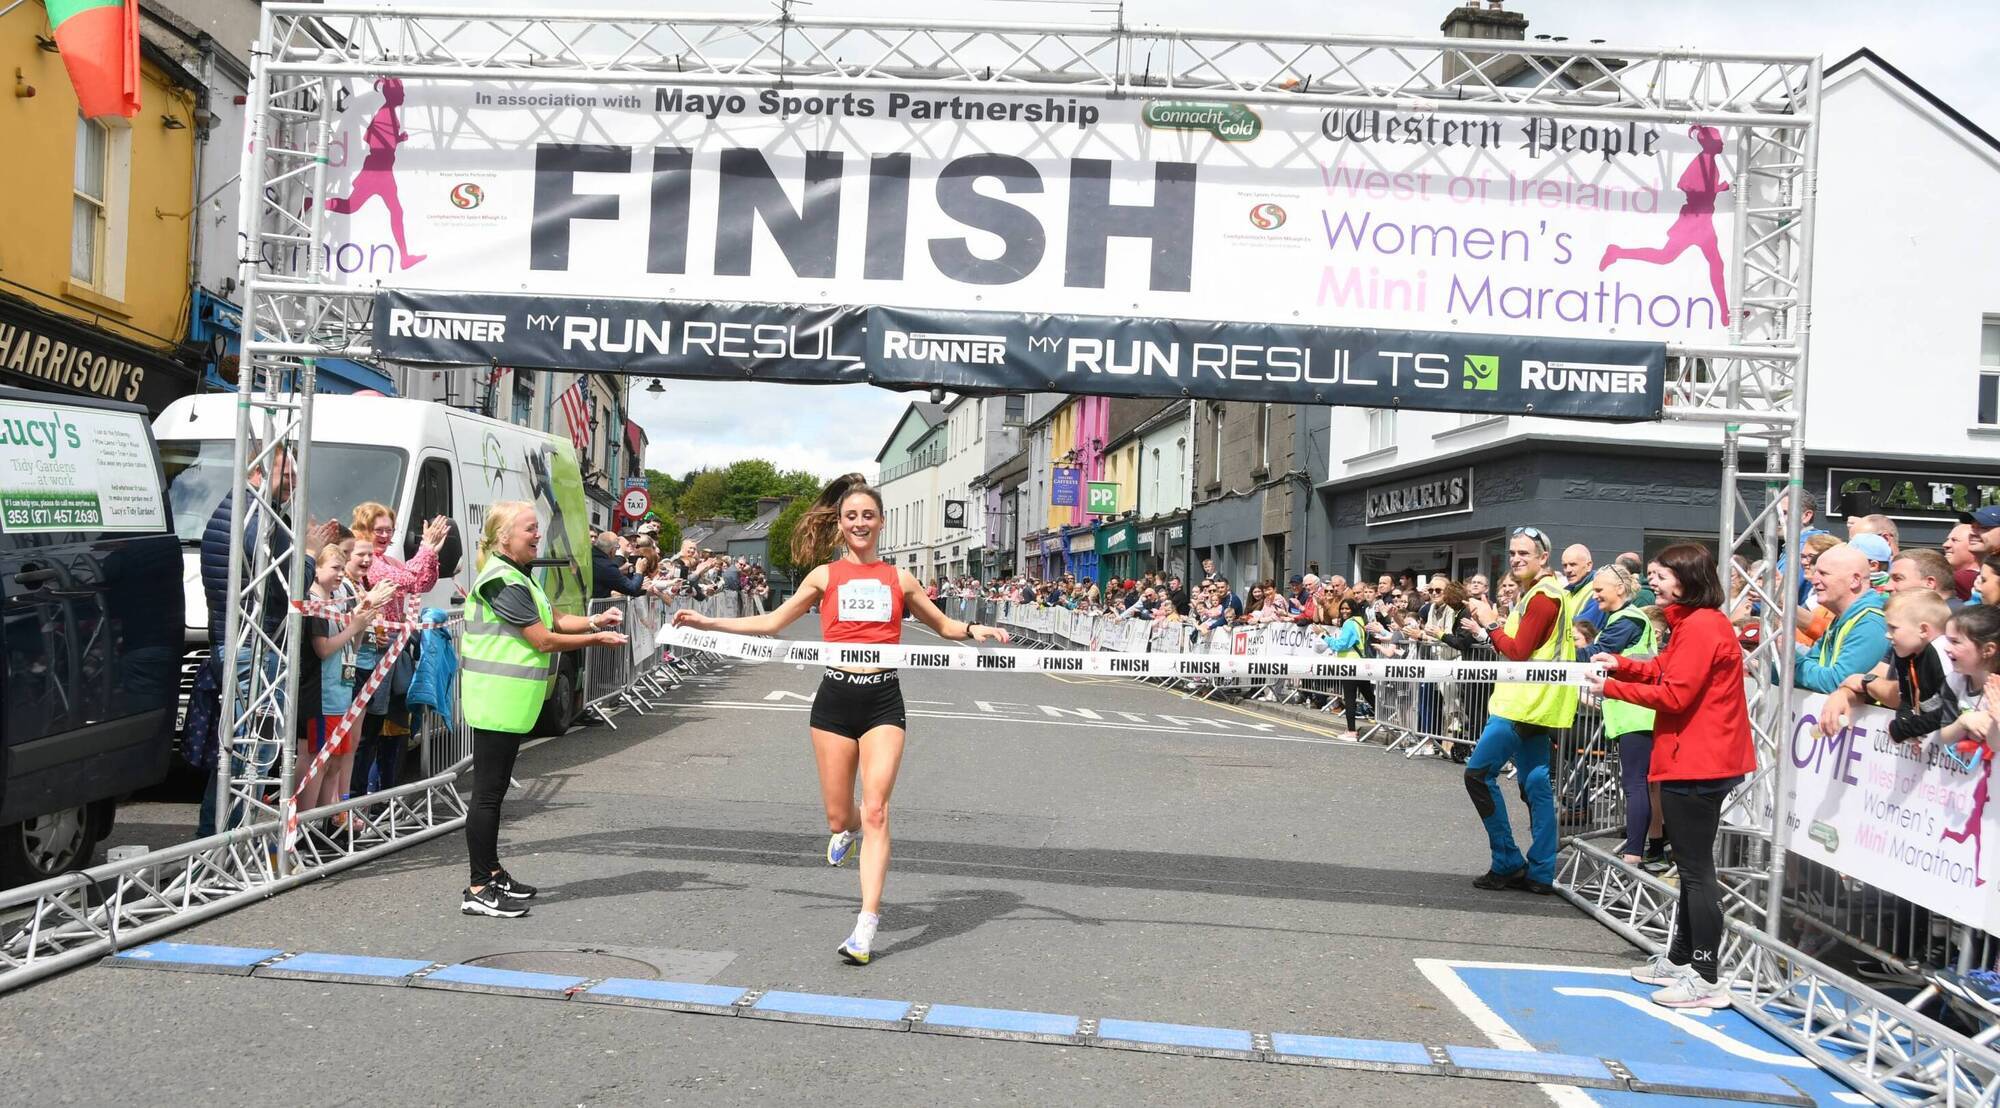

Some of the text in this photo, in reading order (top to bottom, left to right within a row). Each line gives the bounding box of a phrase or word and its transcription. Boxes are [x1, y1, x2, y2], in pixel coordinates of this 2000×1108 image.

[476, 87, 1099, 130] In association with Mayo Sports Partnership
[1149, 104, 1224, 125] Connacht
[1219, 119, 1255, 136] Gold
[1319, 107, 1661, 164] Western People
[1319, 161, 1659, 214] West of Ireland
[529, 142, 1197, 293] FINISH
[1321, 209, 1573, 265] Women's
[1316, 265, 1714, 330] Mini Marathon
[389, 308, 506, 344] RUNNER
[526, 313, 868, 362] MY RUN RESUL
[0, 323, 145, 402] HARRISON'S
[883, 330, 1007, 365] RUNNER
[1028, 335, 1450, 390] MY RUN RESULTS
[1520, 359, 1648, 394] RUNNER
[10, 458, 77, 475] Tidy Gardens
[627, 501, 643, 509] TAXI
[1367, 476, 1464, 519] CARMEL'S
[7, 508, 99, 524] 353 (87) 457 2630
[841, 598, 875, 610] 1232
[1248, 635, 1265, 646] MAYO
[1271, 629, 1314, 649] WELCOME
[681, 633, 1567, 682] FINISH FINISH FINISH FINISH FINISH FINISH FINISH FINISH FINISH FINISH FINISH FINISH FINISH FINISH
[825, 668, 845, 681] RO
[848, 673, 882, 685] NIKE
[974, 700, 1277, 733] ENTRY
[1864, 789, 1935, 837] Women's
[1854, 821, 1888, 855] Mini
[1888, 836, 1975, 889] Marathon
[1692, 949, 1712, 962] CK
